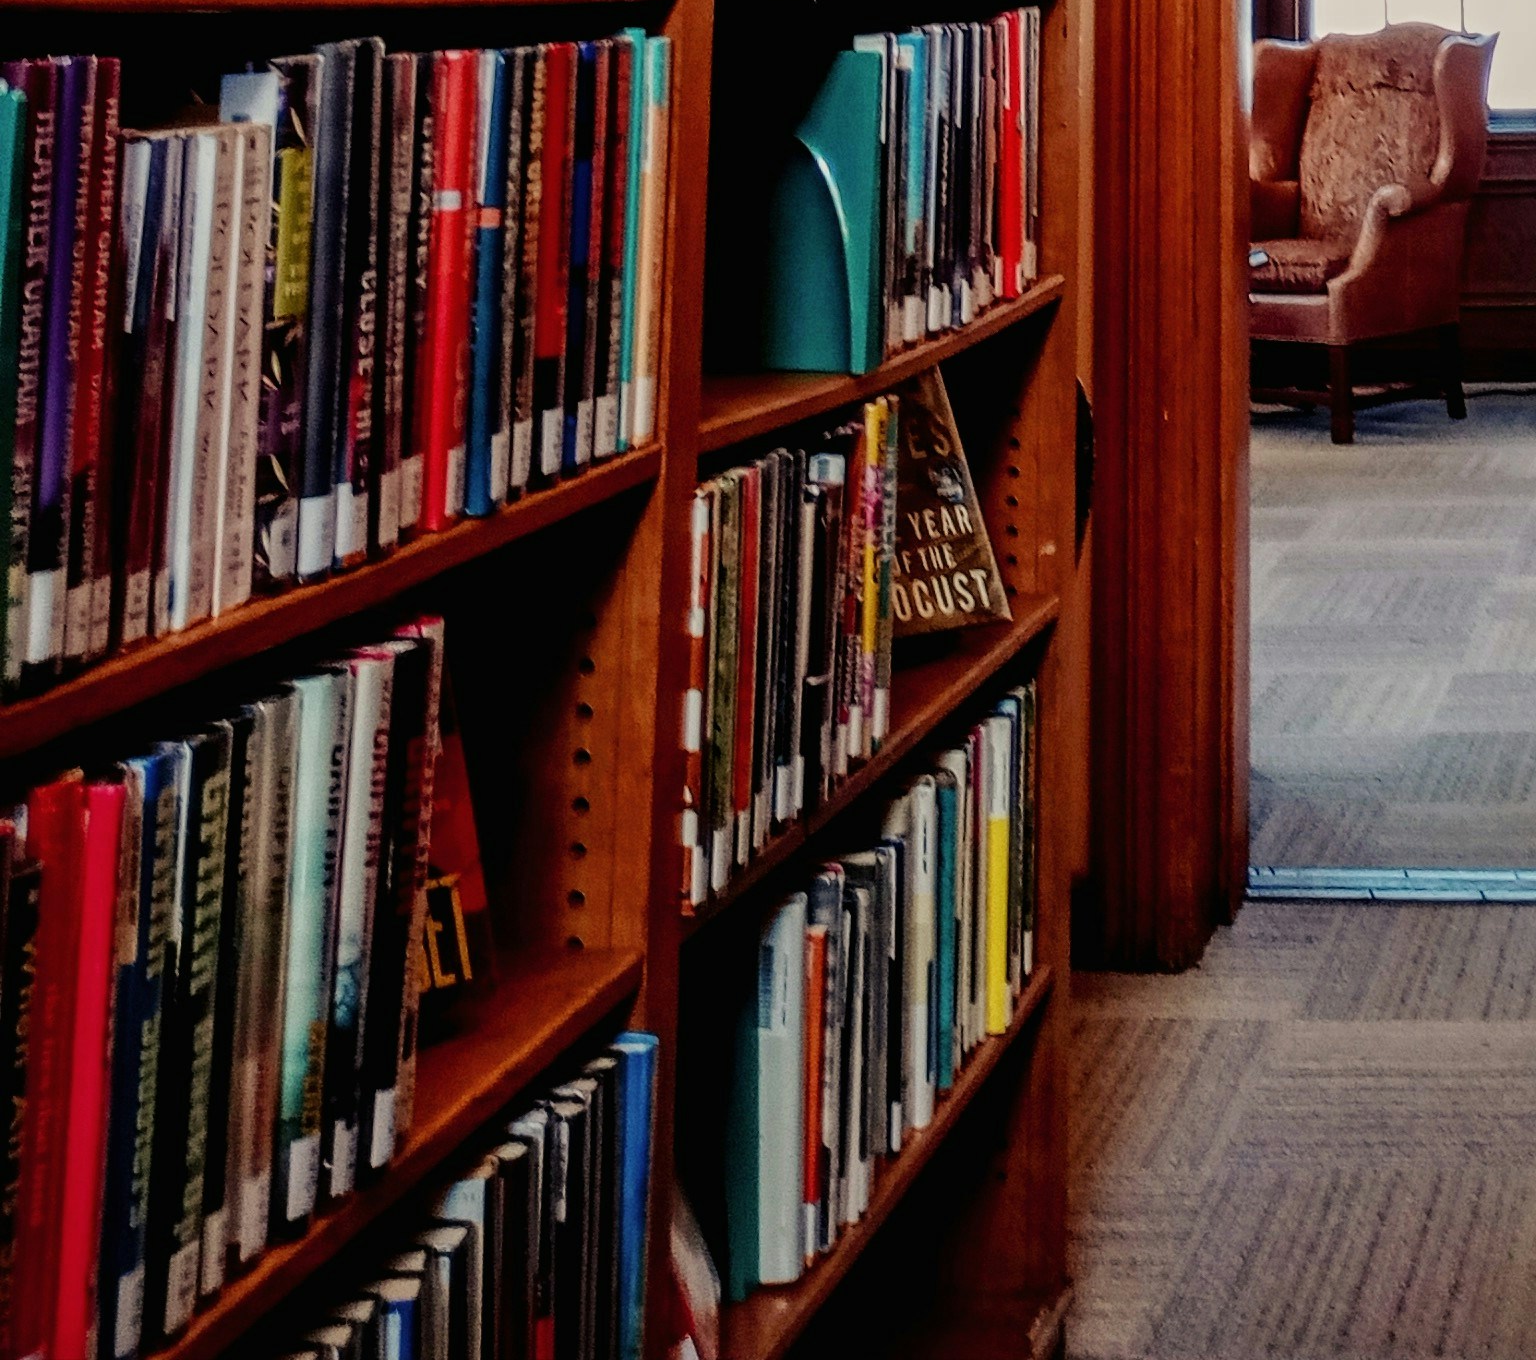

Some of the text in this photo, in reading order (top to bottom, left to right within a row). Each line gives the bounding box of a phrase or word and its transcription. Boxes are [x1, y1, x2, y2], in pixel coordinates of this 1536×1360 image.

[26, 110, 56, 272] HEATHER
[91, 96, 121, 352] HEATHER GRAHAM
[14, 278, 44, 427] GRAHAM
[906, 503, 974, 542] YEAR
[916, 541, 958, 573] THE
[891, 567, 992, 622] OCUST
